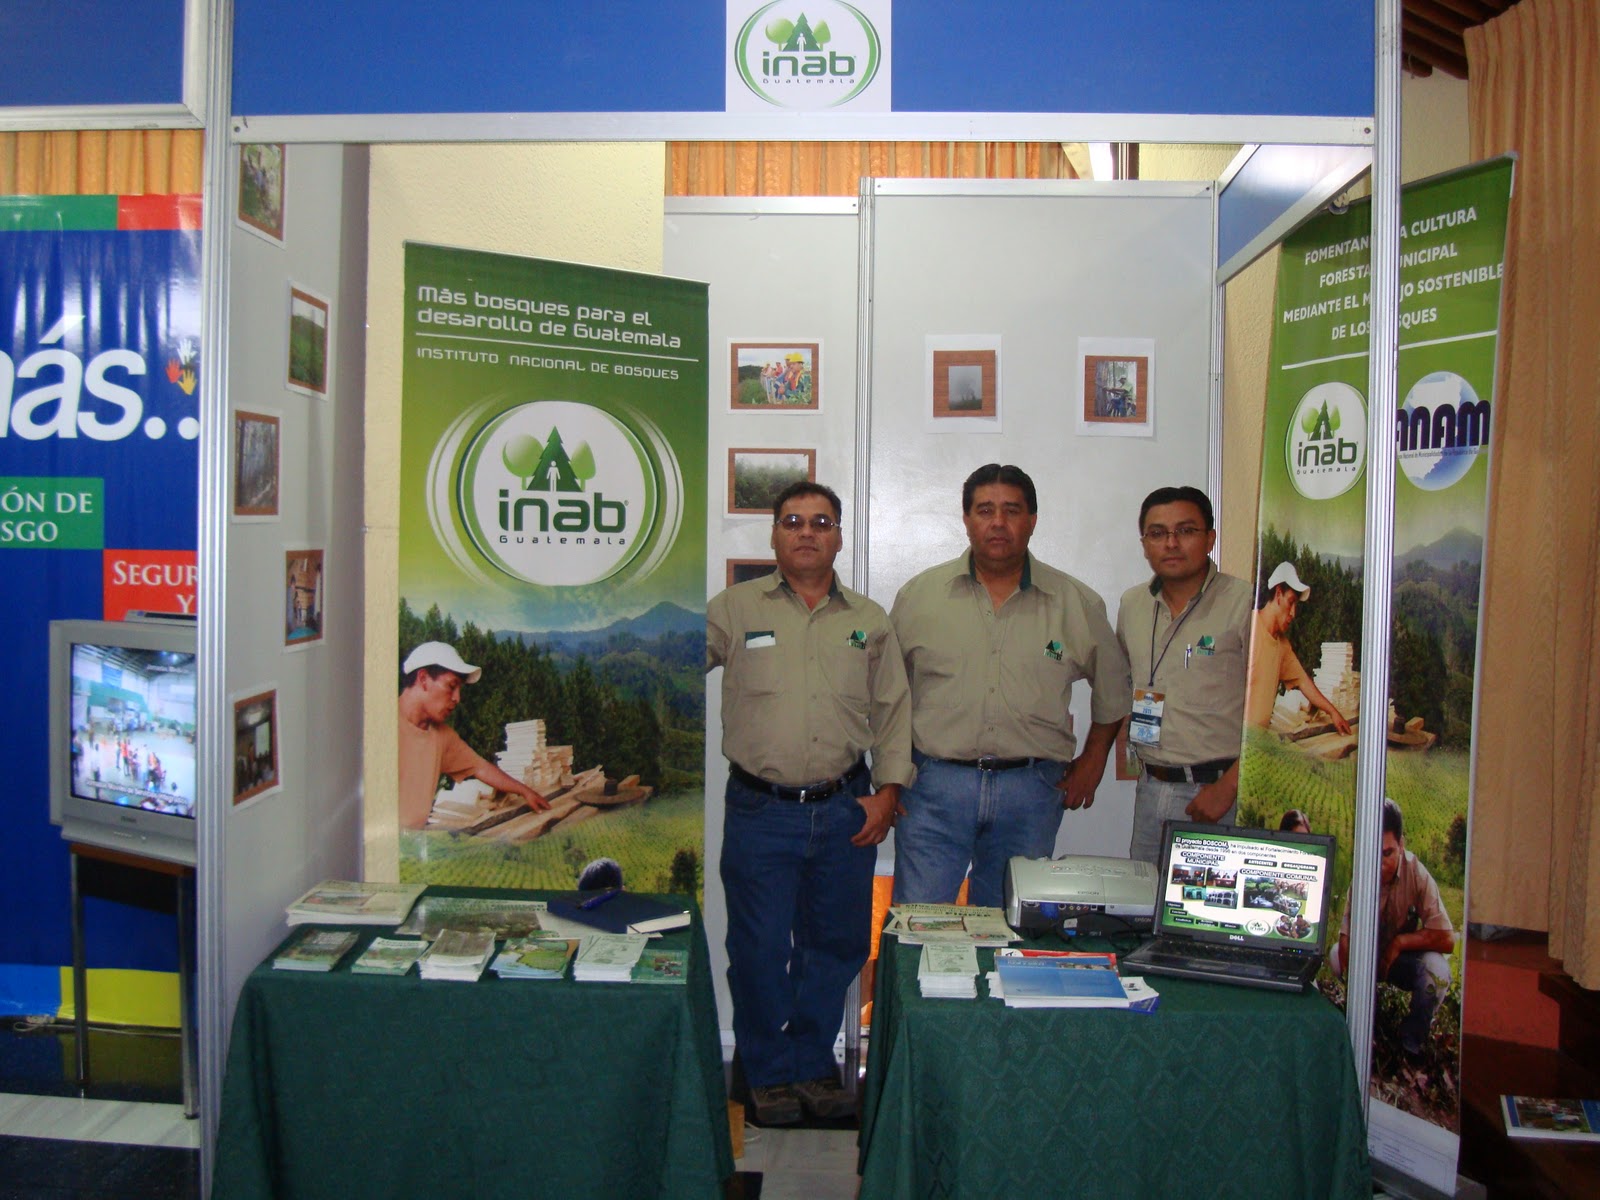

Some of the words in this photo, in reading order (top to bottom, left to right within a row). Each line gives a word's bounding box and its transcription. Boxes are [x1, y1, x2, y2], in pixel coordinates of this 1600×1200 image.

[762, 51, 856, 77] inab
[1304, 235, 1370, 266] FOMENTAN
[1411, 206, 1478, 237] CULTURA
[1319, 263, 1371, 288] FORESTA
[1283, 296, 1342, 324] MEDIANTE
[1344, 295, 1360, 310] EL
[1417, 262, 1504, 297] SOSTENIBLE
[474, 291, 571, 317] bosques
[576, 305, 626, 325] para
[632, 310, 652, 327] el
[417, 308, 533, 334] desarollo
[539, 319, 567, 337] de
[573, 322, 682, 349] Guatemala
[1331, 325, 1346, 341] DE
[416, 347, 499, 365] INSTITUTO
[509, 354, 586, 372] NACIONAL
[591, 362, 609, 375] DE
[614, 364, 680, 381] BOSQUES
[1297, 436, 1358, 468] inab
[1296, 465, 1357, 476] Guatemala
[55, 491, 93, 514] DE
[498, 488, 627, 534] inab
[499, 535, 626, 545] Guatemala
[176, 593, 195, 615] Y
[1181, 851, 1226, 861] COMPONENTE
[1186, 858, 1219, 867] MUNICIPAL
[1240, 868, 1285, 879] COMPONENTE
[1285, 873, 1318, 882] COMUNAL
